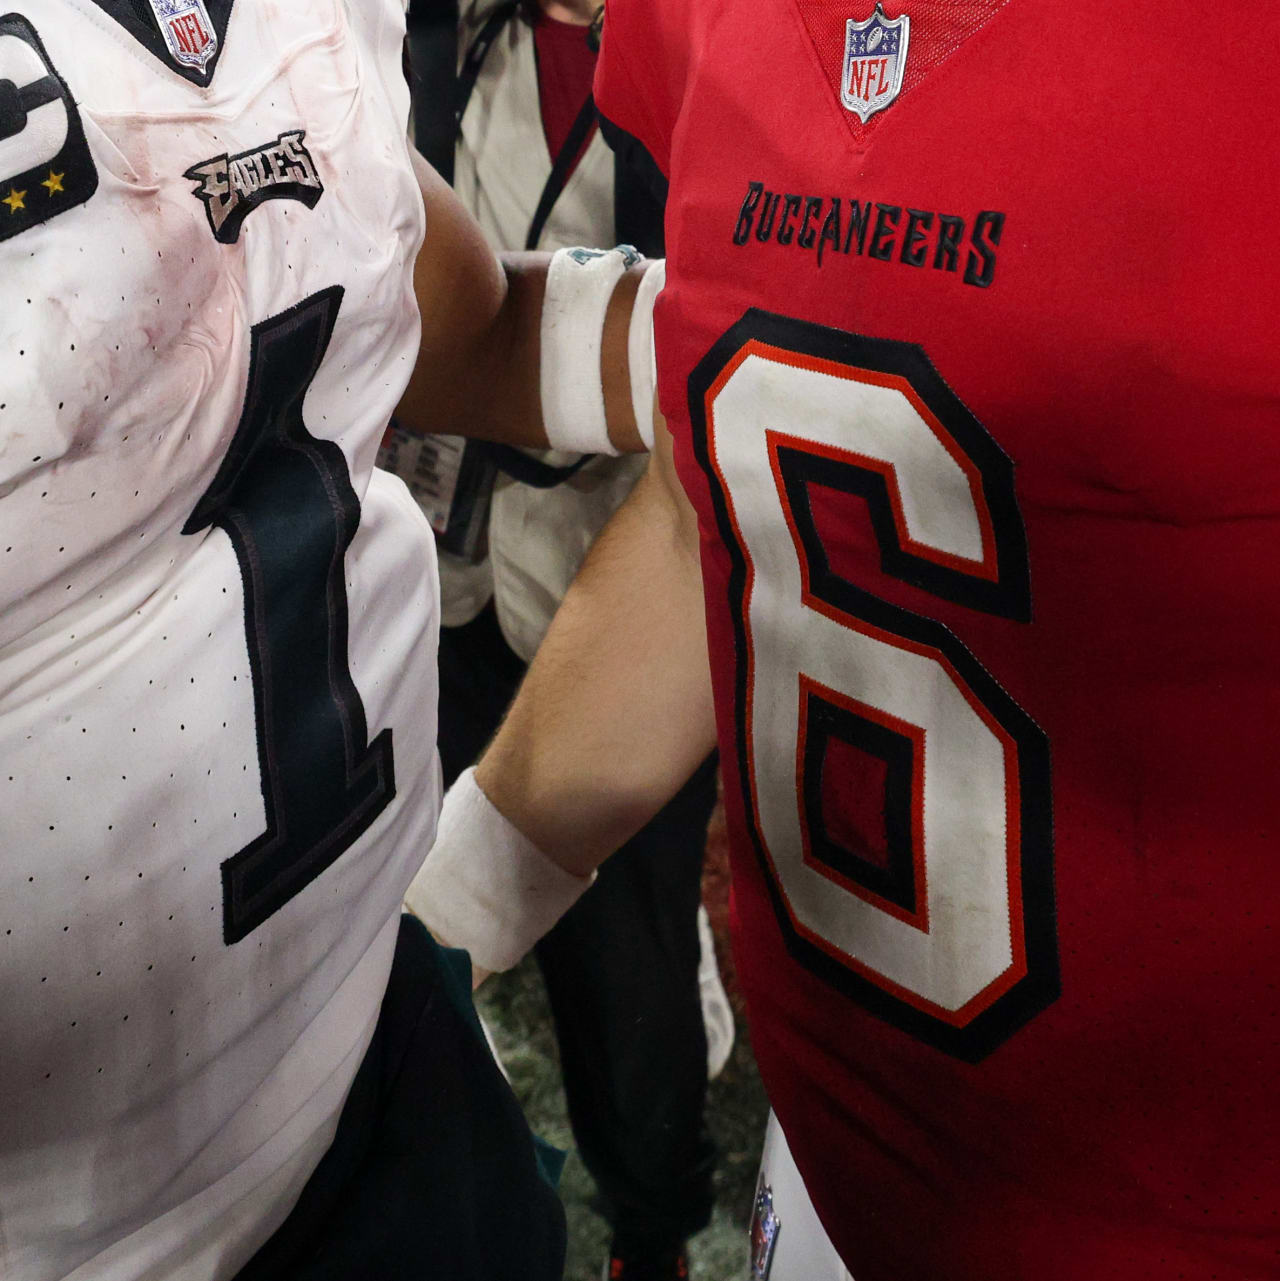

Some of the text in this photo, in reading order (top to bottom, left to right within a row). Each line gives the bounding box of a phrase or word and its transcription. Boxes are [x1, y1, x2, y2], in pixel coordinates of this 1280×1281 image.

[169, 13, 209, 54] NFL
[848, 58, 890, 102] NFL
[185, 131, 323, 236] EAGLES
[732, 180, 1007, 289] BUCCANEERS
[181, 284, 396, 946] 1
[688, 307, 1062, 1065] 6
